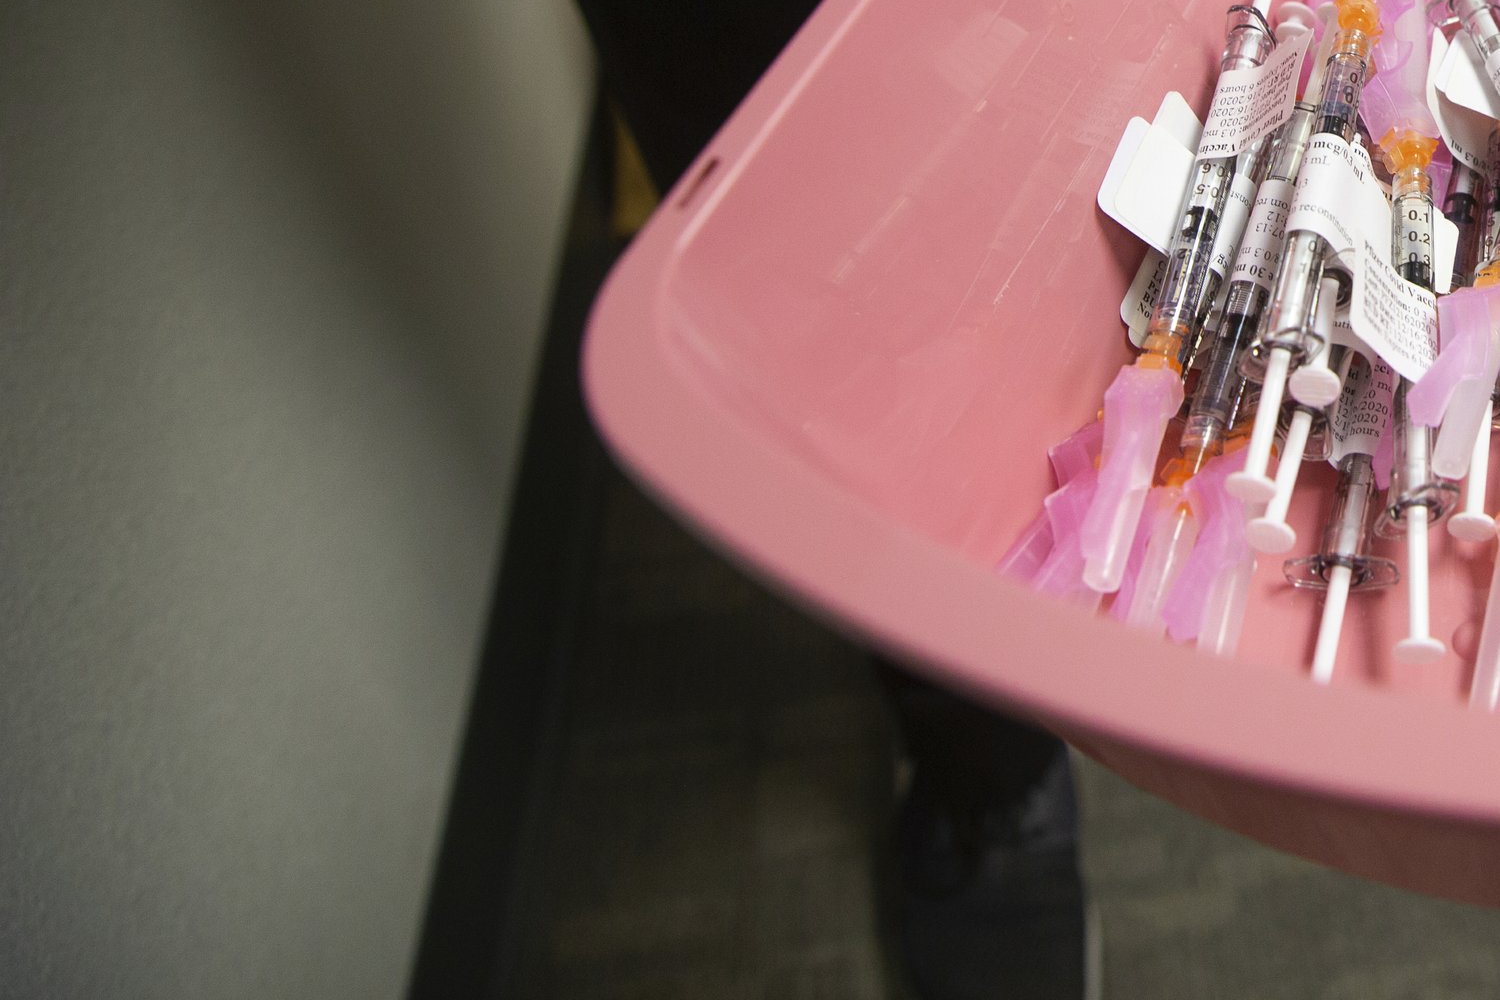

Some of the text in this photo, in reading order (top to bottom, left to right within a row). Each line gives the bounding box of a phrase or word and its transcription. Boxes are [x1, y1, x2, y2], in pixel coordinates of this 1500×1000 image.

[1408, 210, 1430, 224] 0.1
[1256, 223, 1284, 240] 07:13
[1408, 230, 1431, 245] 0.2
[1408, 251, 1431, 266] 0.3
